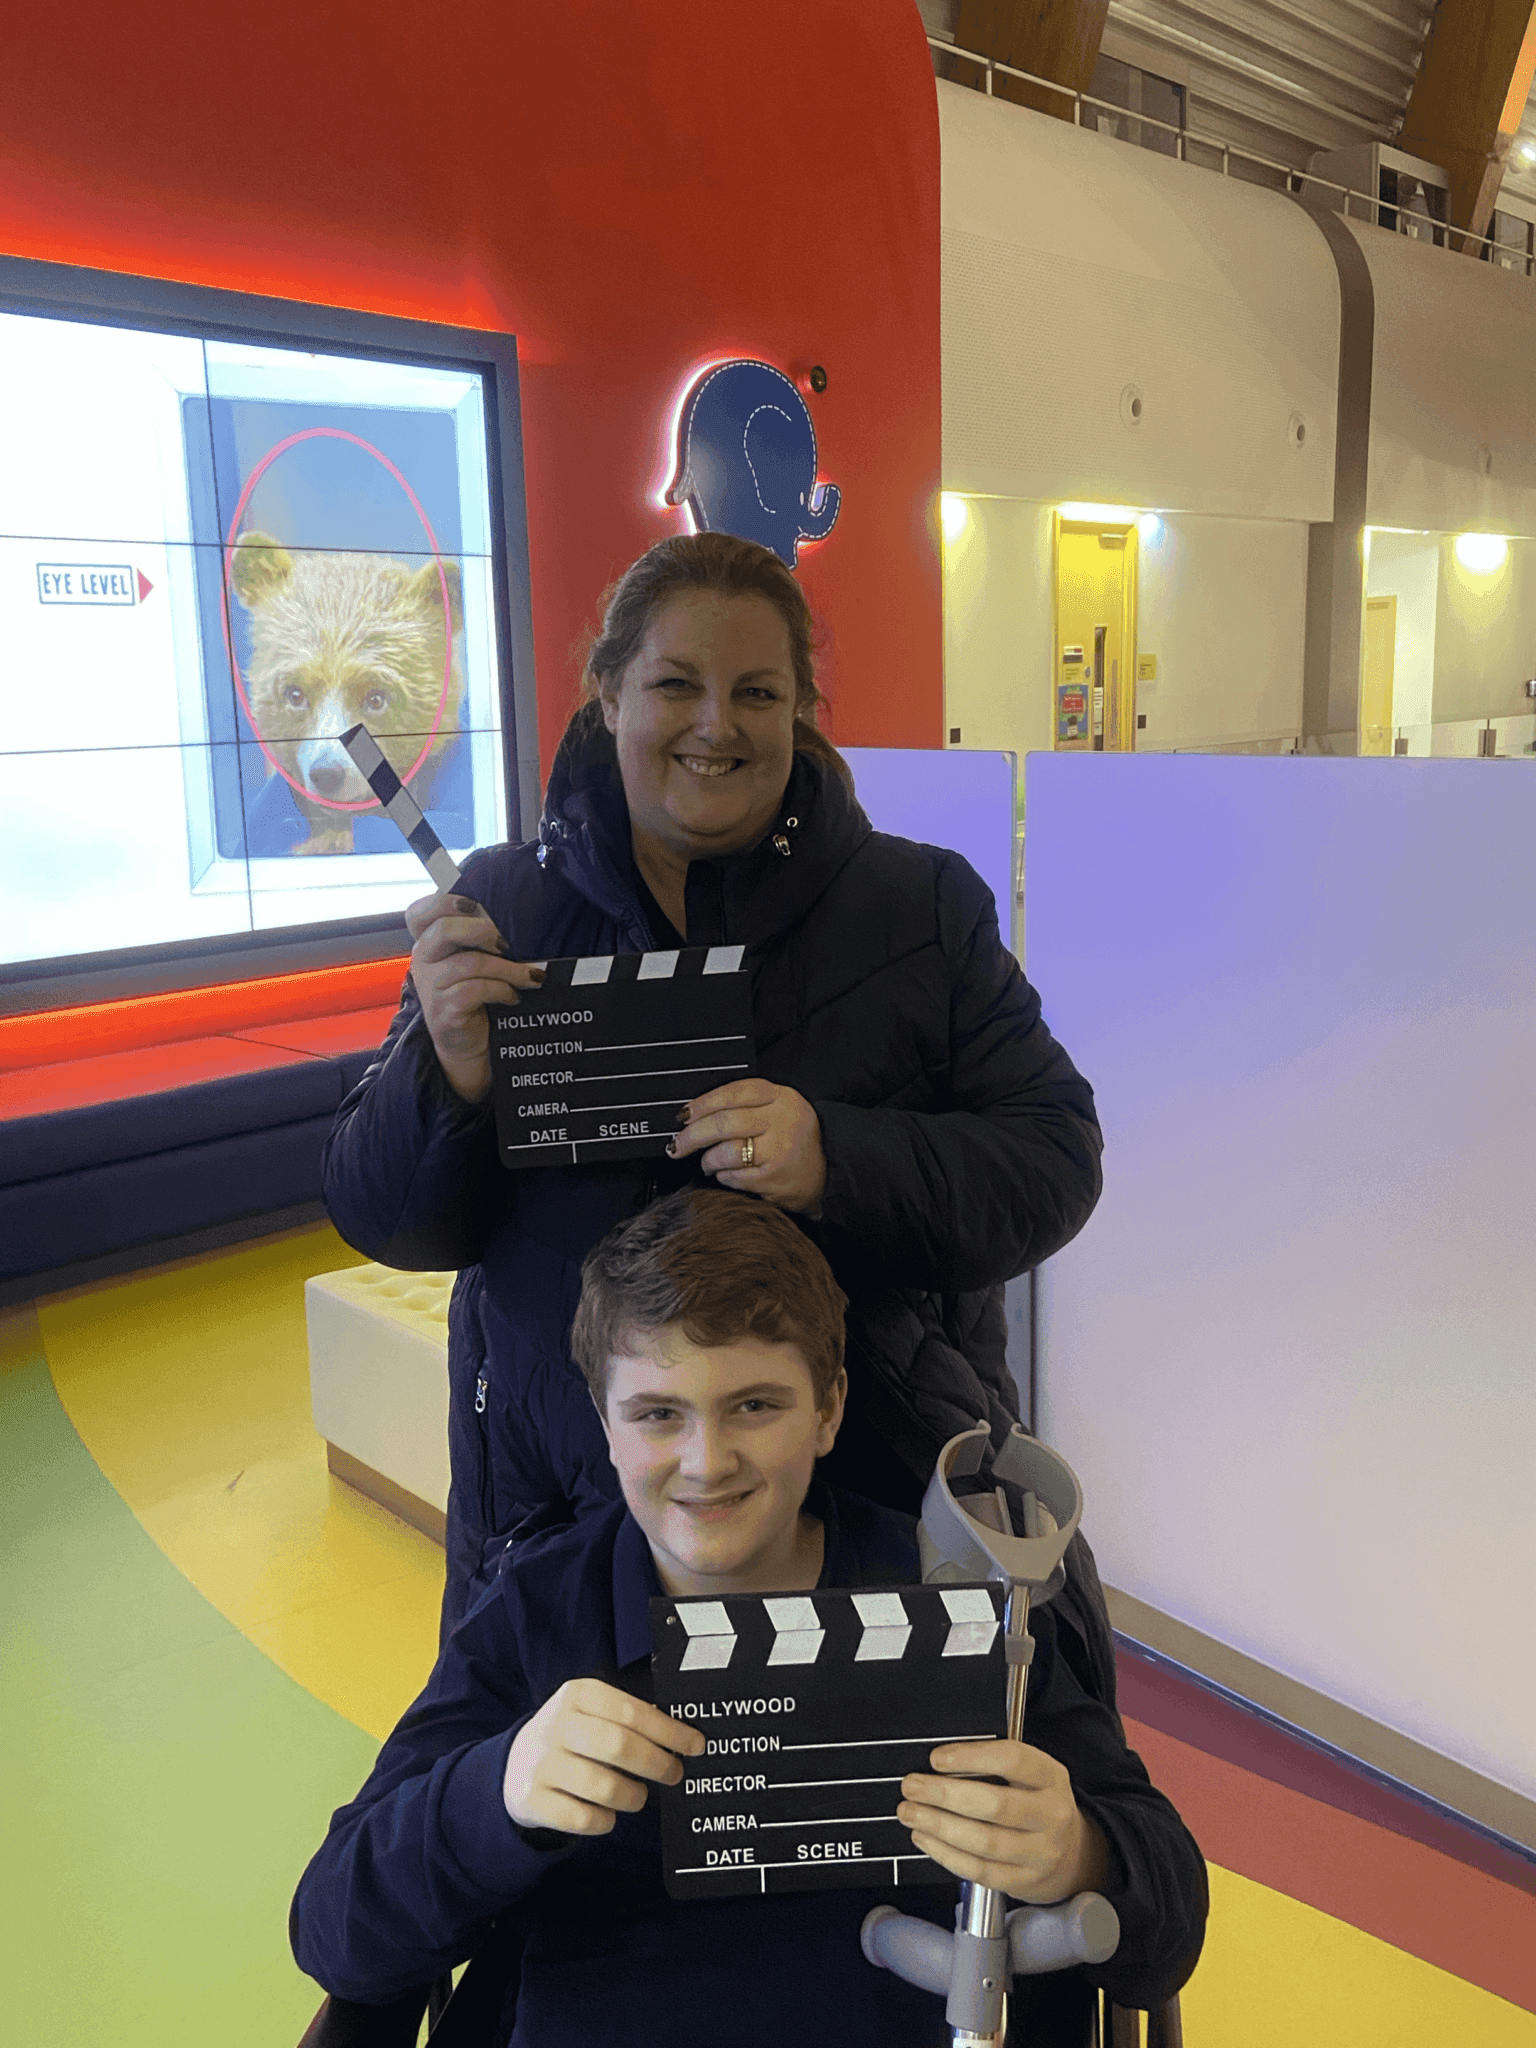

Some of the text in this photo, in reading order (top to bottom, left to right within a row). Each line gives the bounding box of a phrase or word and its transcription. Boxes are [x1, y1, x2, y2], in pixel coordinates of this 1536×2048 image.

[43, 573, 129, 595] EYE LEVEL
[497, 1010, 594, 1030] HOLLYWOOD
[499, 1041, 583, 1059] PRODUCTION
[511, 1071, 574, 1087] DIRECTOR
[517, 1102, 569, 1118] CAMERA
[530, 1121, 650, 1143] DATE SCENE
[670, 1697, 796, 1719] HOLLYWOOD
[707, 1735, 780, 1755] DUCTION
[685, 1775, 767, 1794] DIRECTOR
[691, 1814, 758, 1833] CAMERA
[706, 1841, 863, 1866] DATE SCENE
